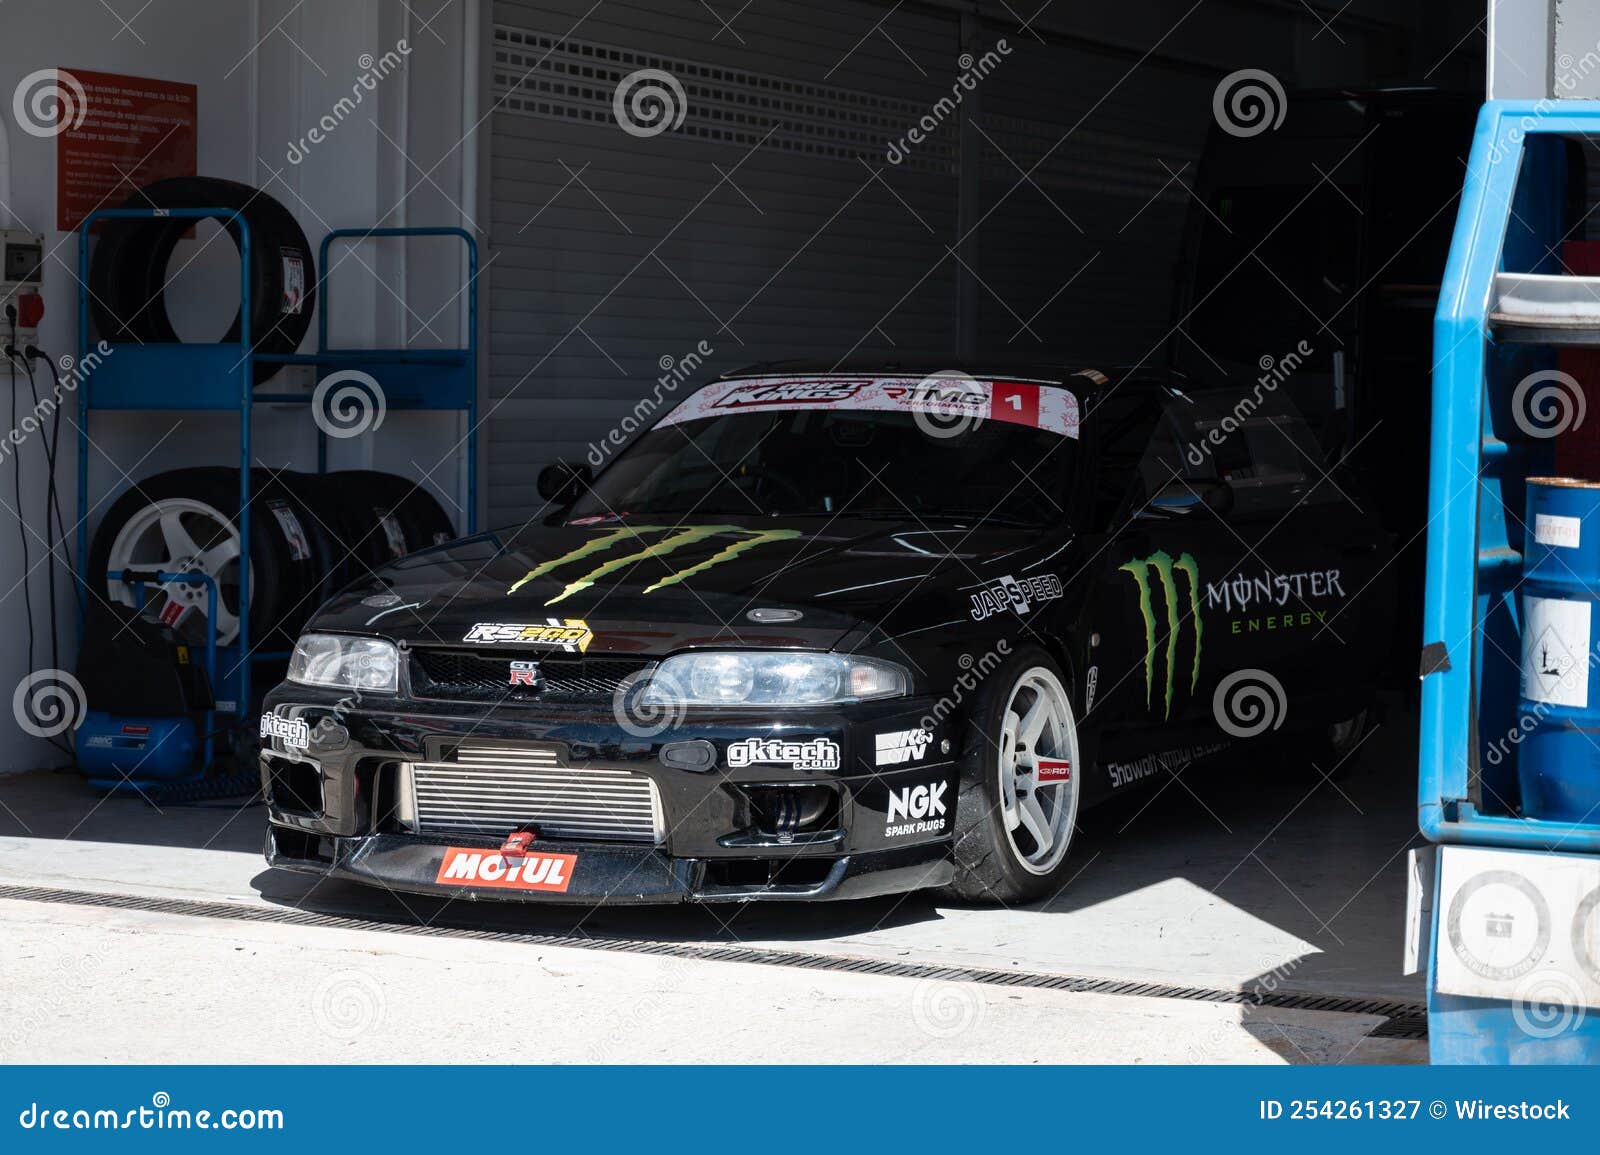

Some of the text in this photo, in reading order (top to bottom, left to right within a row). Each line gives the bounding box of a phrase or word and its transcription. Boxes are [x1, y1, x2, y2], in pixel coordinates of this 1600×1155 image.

[1005, 394, 1023, 410] 1
[970, 574, 1063, 621] JAPSPEED
[1207, 569, 1346, 613] MONSTER
[1231, 610, 1328, 634] ENERGY
[260, 712, 308, 739] gktech
[727, 738, 841, 768] gktech
[886, 780, 948, 824] NGK
[885, 818, 945, 838] SPARK PLUGS
[444, 852, 566, 885] MOTUL
